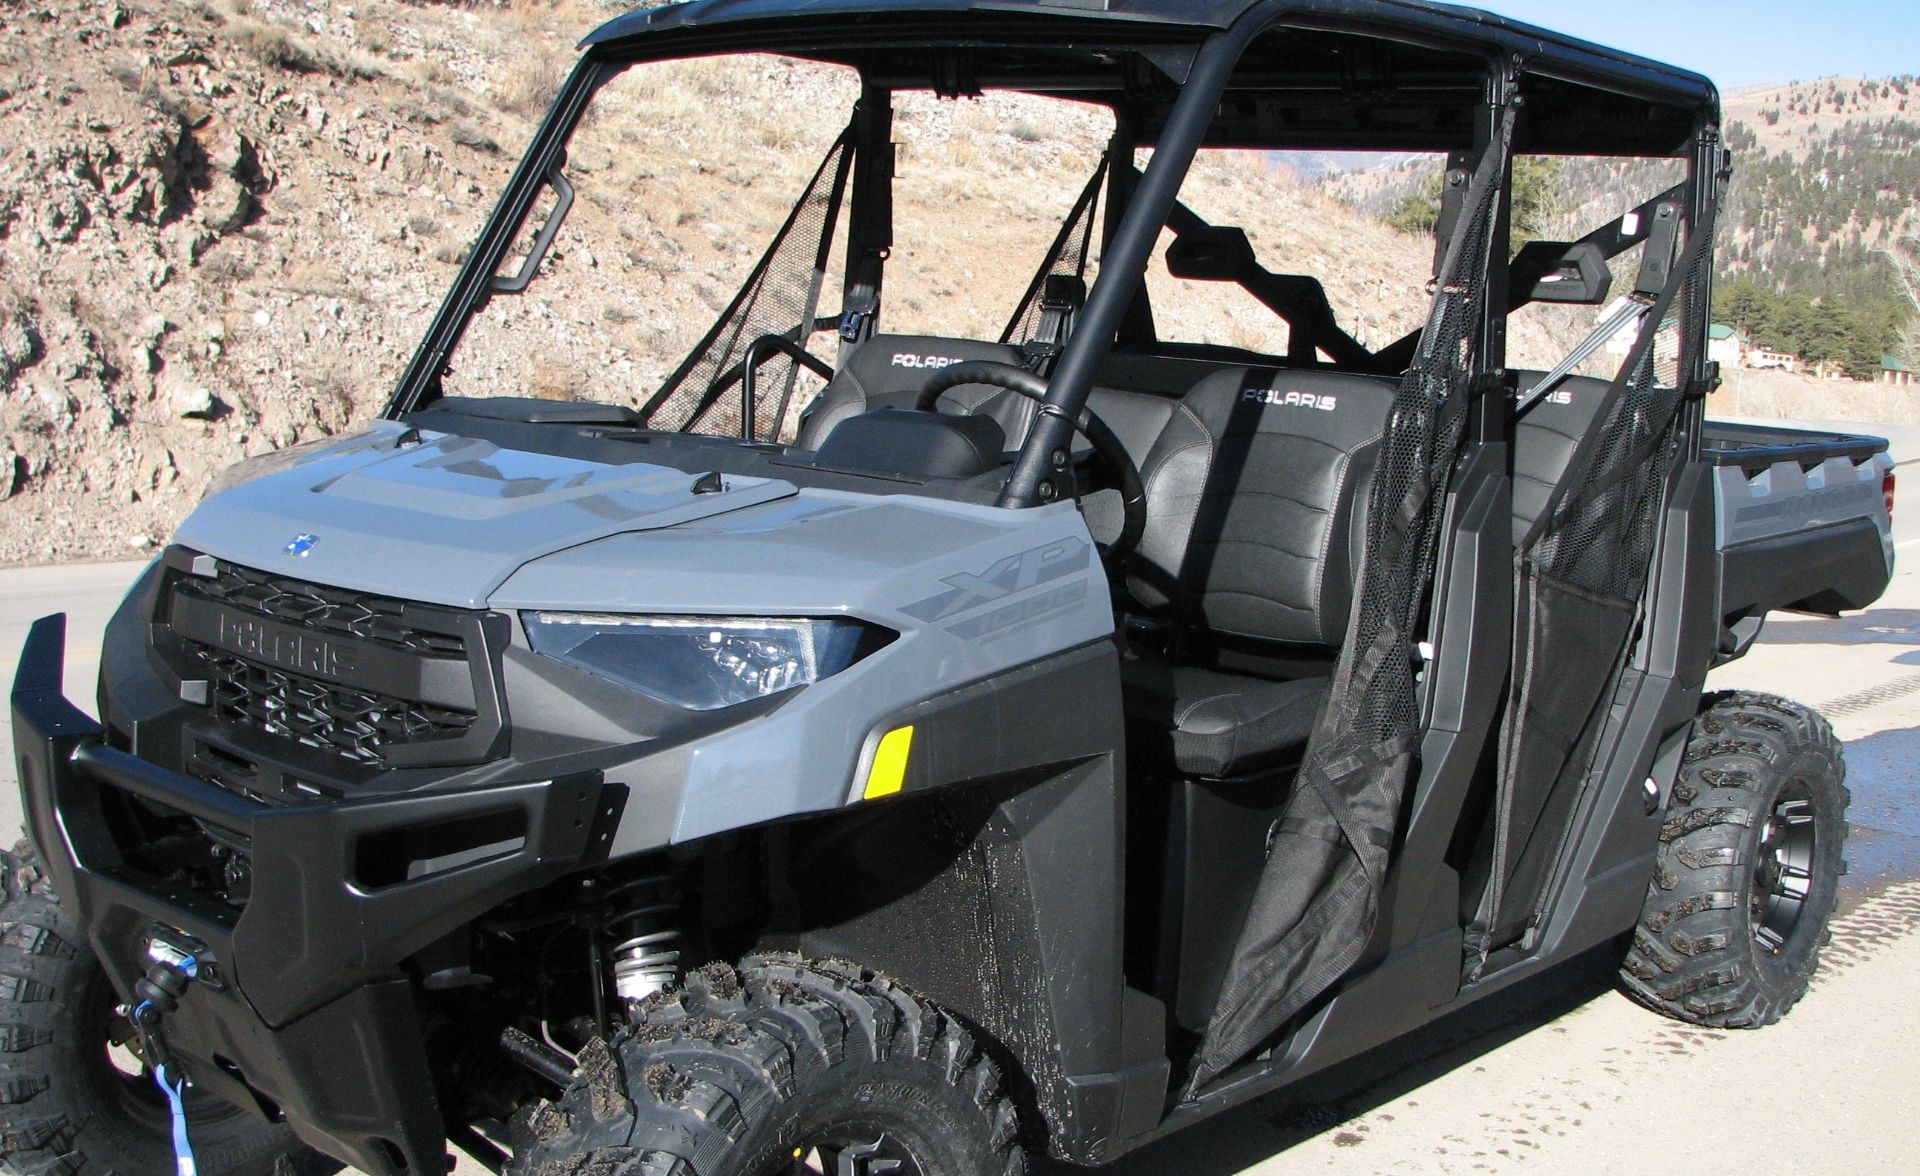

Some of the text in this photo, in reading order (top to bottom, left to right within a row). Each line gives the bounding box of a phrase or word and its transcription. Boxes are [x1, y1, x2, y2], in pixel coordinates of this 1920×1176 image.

[1242, 388, 1337, 411] POLARIS
[897, 535, 1091, 624] XP
[219, 611, 357, 677] POLARIS
